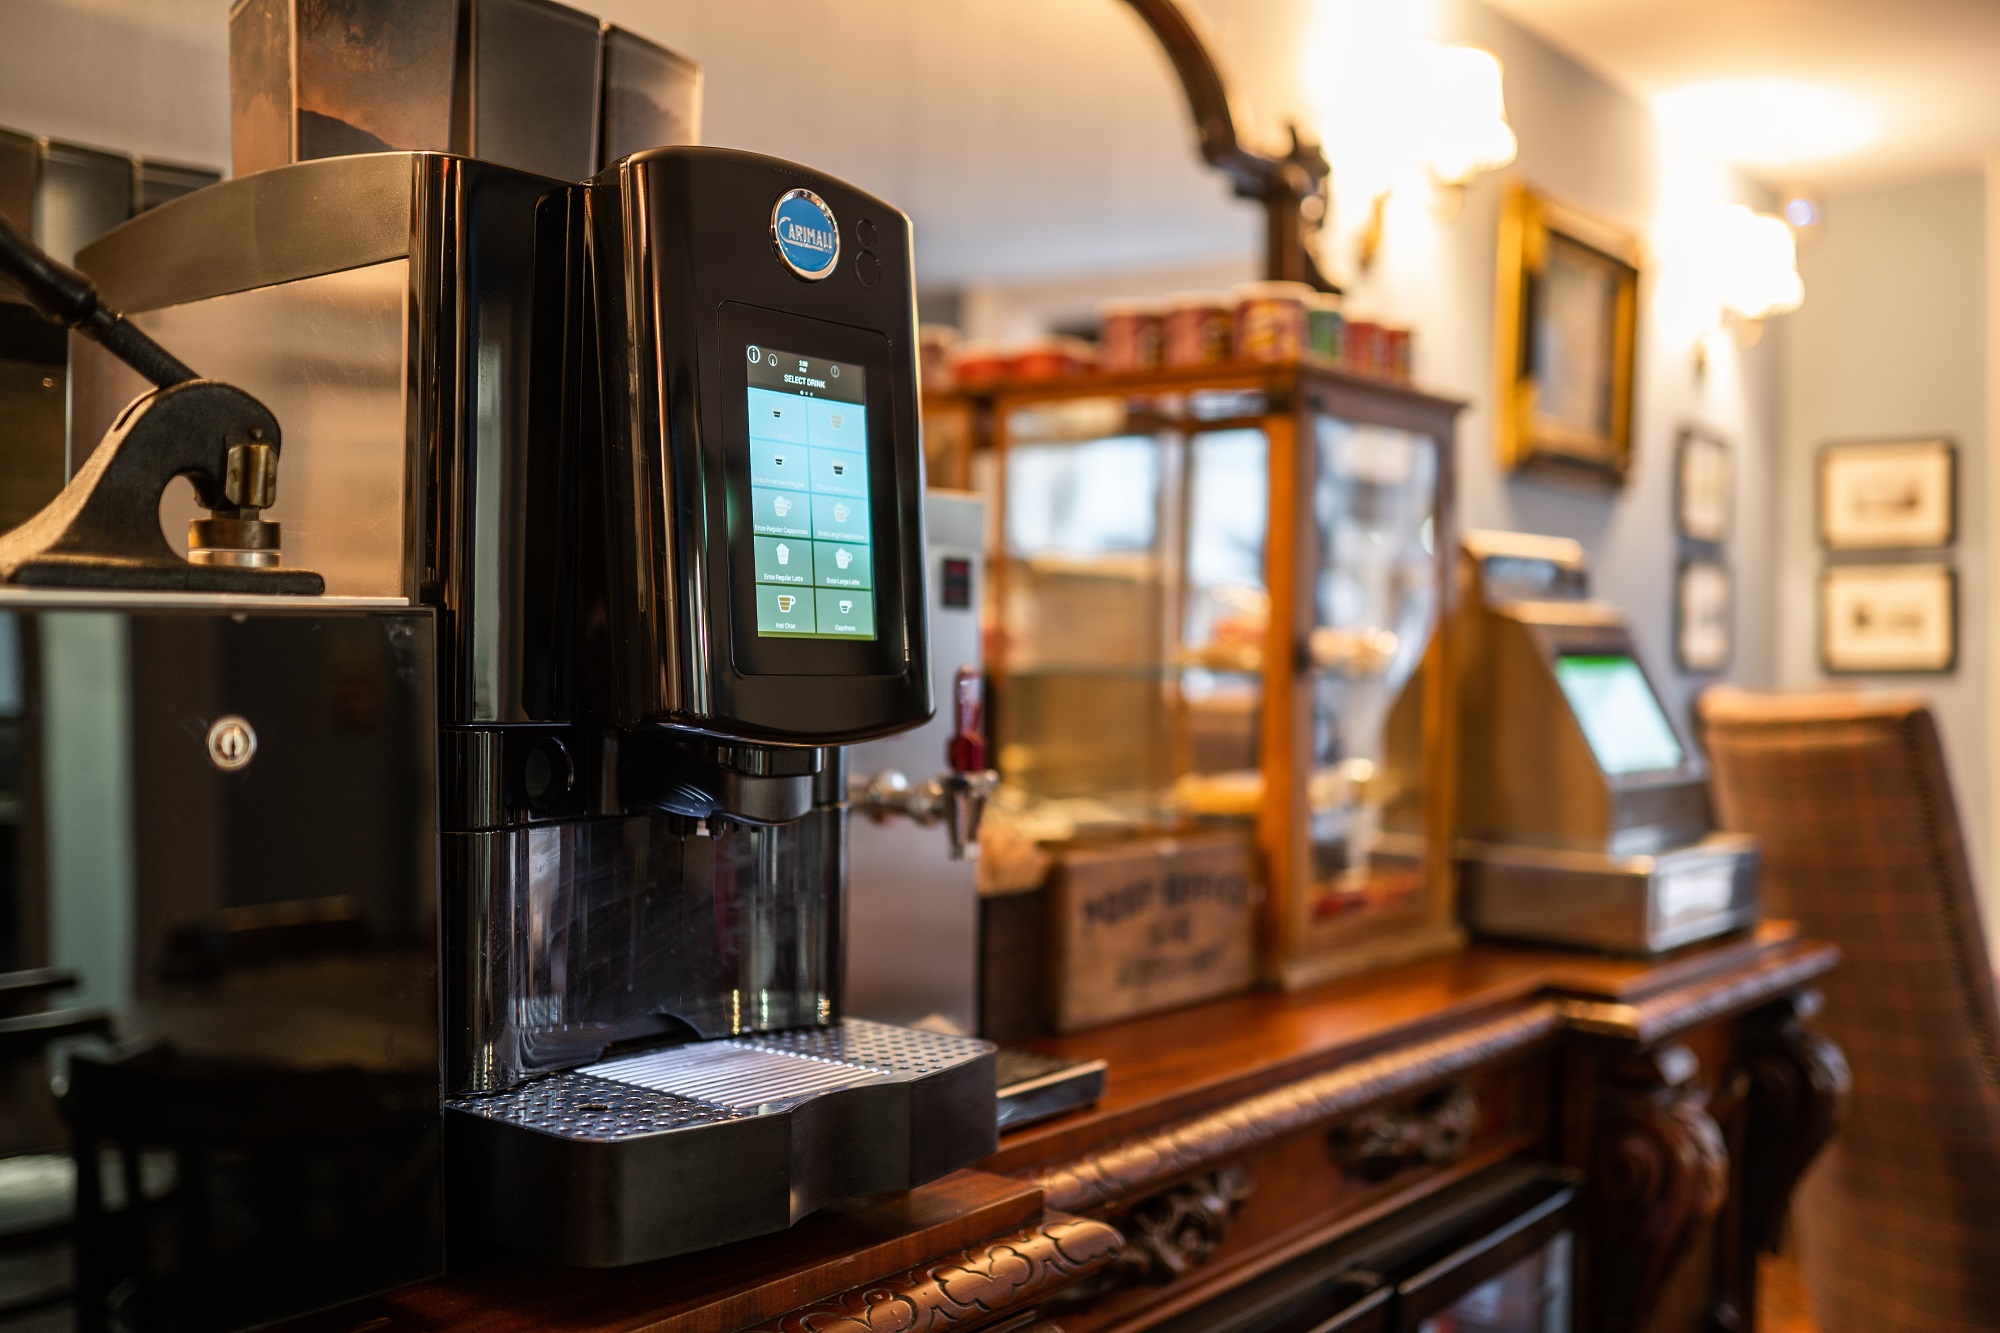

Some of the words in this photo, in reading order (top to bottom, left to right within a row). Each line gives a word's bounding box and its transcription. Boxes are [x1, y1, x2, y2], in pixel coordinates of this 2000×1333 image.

[778, 216, 832, 250] CARIMALI
[784, 374, 806, 385] SELECT
[807, 378, 826, 389] DRINK
[783, 527, 808, 536] Cappuccino
[837, 578, 849, 586] Large
